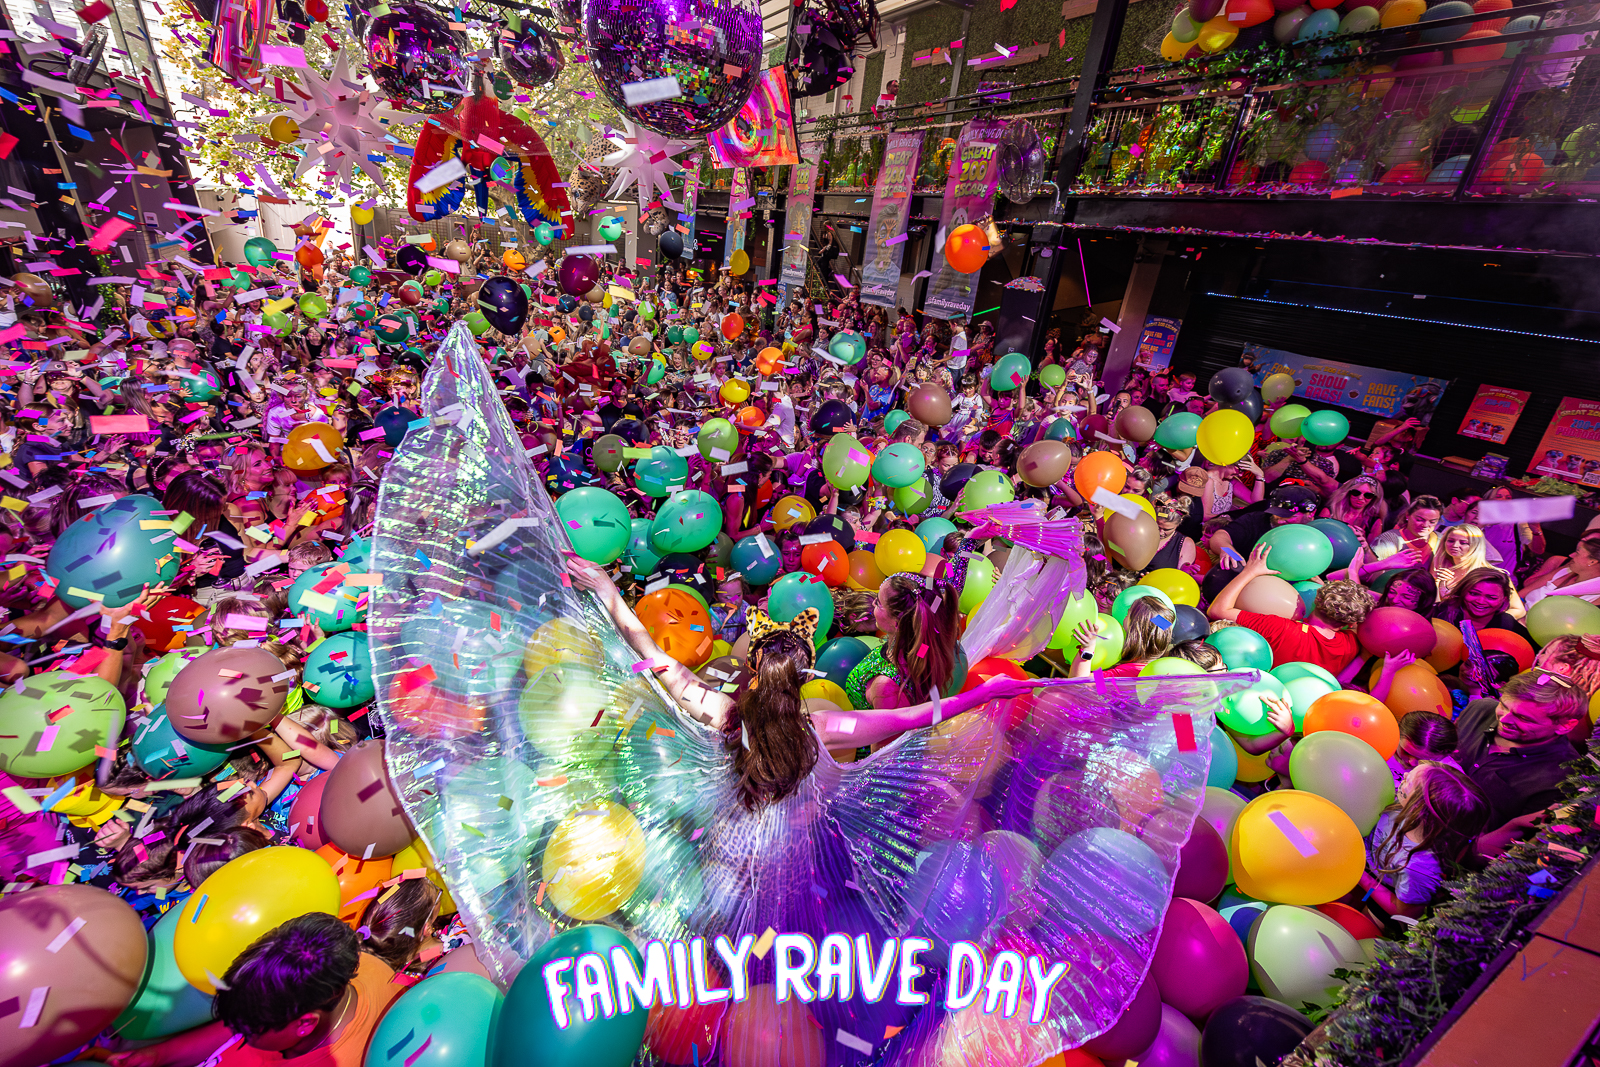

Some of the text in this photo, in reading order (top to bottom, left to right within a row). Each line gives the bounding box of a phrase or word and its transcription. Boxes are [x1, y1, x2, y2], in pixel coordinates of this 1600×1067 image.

[885, 151, 913, 167] GREAT
[961, 144, 997, 162] GREAT
[884, 165, 906, 185] ZOO
[959, 160, 989, 182] ZOO
[954, 182, 989, 199] ESCAPE
[926, 296, 971, 312] @familyraveday
[1309, 372, 1348, 390] SHOW
[1367, 382, 1398, 397] RAVE
[1305, 385, 1343, 403] BAGS!
[1362, 394, 1396, 412] FANS!
[1587, 409, 1600, 417] ZO
